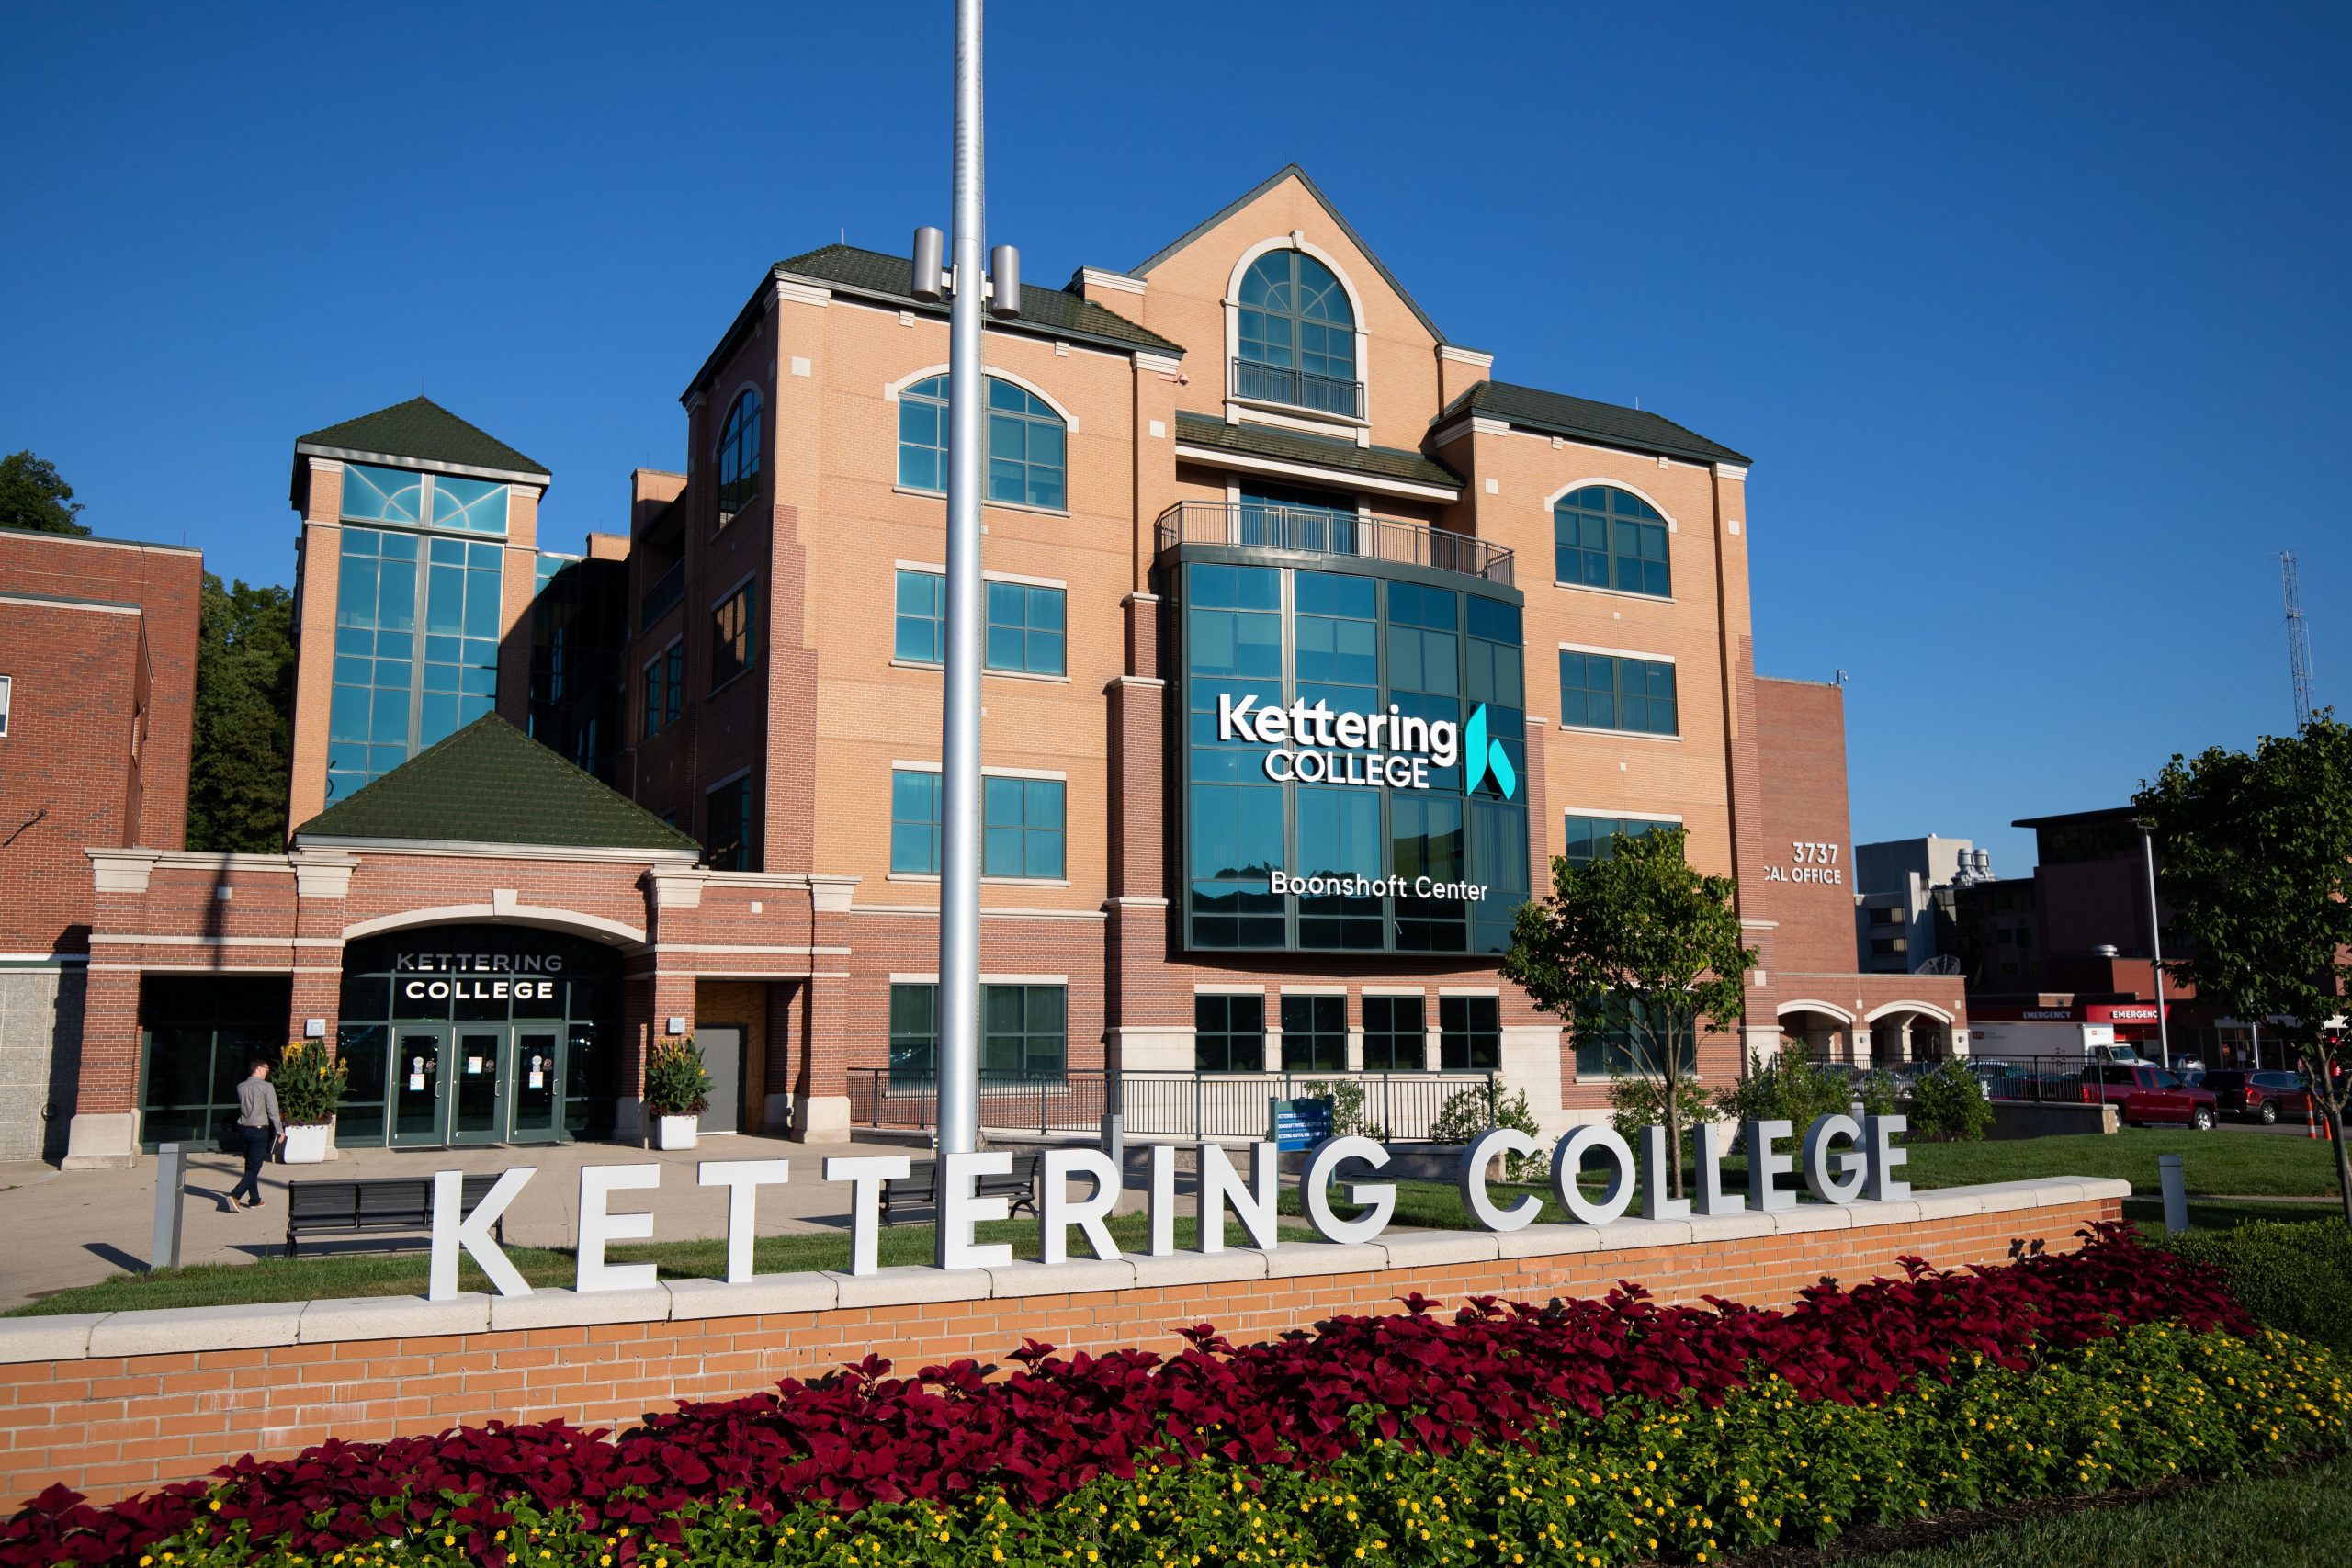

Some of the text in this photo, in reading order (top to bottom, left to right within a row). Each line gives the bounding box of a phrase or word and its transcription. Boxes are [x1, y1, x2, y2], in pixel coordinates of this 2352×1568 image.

[1218, 694, 1458, 768] Kettering
[1263, 749, 1430, 789] COLLEGE
[1792, 841, 1838, 863] 3737
[1791, 867, 1841, 884] OFFICE
[1271, 871, 1488, 901] Boonshoft Center
[396, 953, 563, 972] KETTERING
[405, 981, 554, 999] COLLEGE
[2022, 1011, 2072, 1020] EMERGENCY
[2113, 1010, 2158, 1019] EMERGENC
[428, 1113, 1912, 1302] KETTERING COLLEGE
